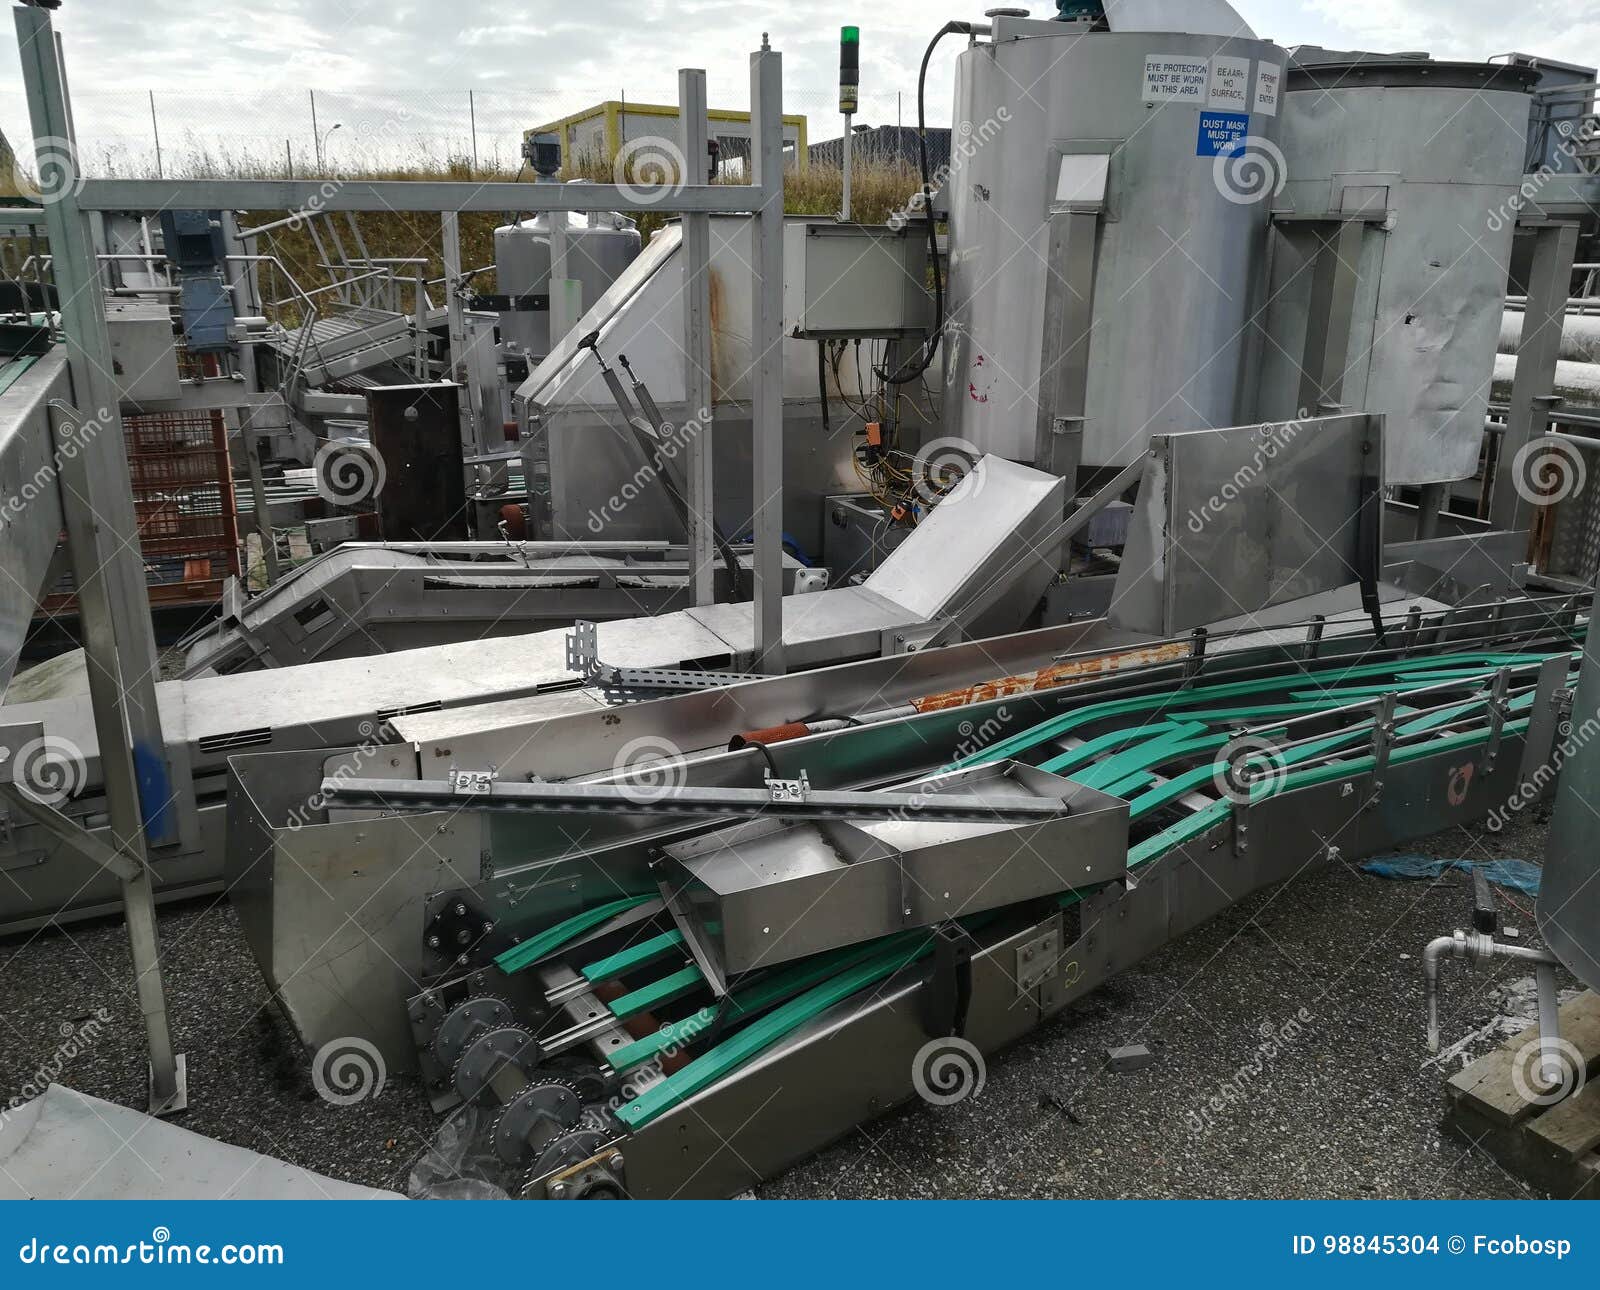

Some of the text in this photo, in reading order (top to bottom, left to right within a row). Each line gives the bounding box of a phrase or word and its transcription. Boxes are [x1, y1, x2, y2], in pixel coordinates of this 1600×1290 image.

[1146, 63, 1207, 74] EYE PROTECTION
[1148, 74, 1204, 85] MUST BE WORN
[1151, 85, 1199, 95] IN THIS AREA
[1202, 119, 1246, 131] DUST MASK
[1207, 129, 1241, 141] MUST BE
[1212, 140, 1236, 151] WORN
